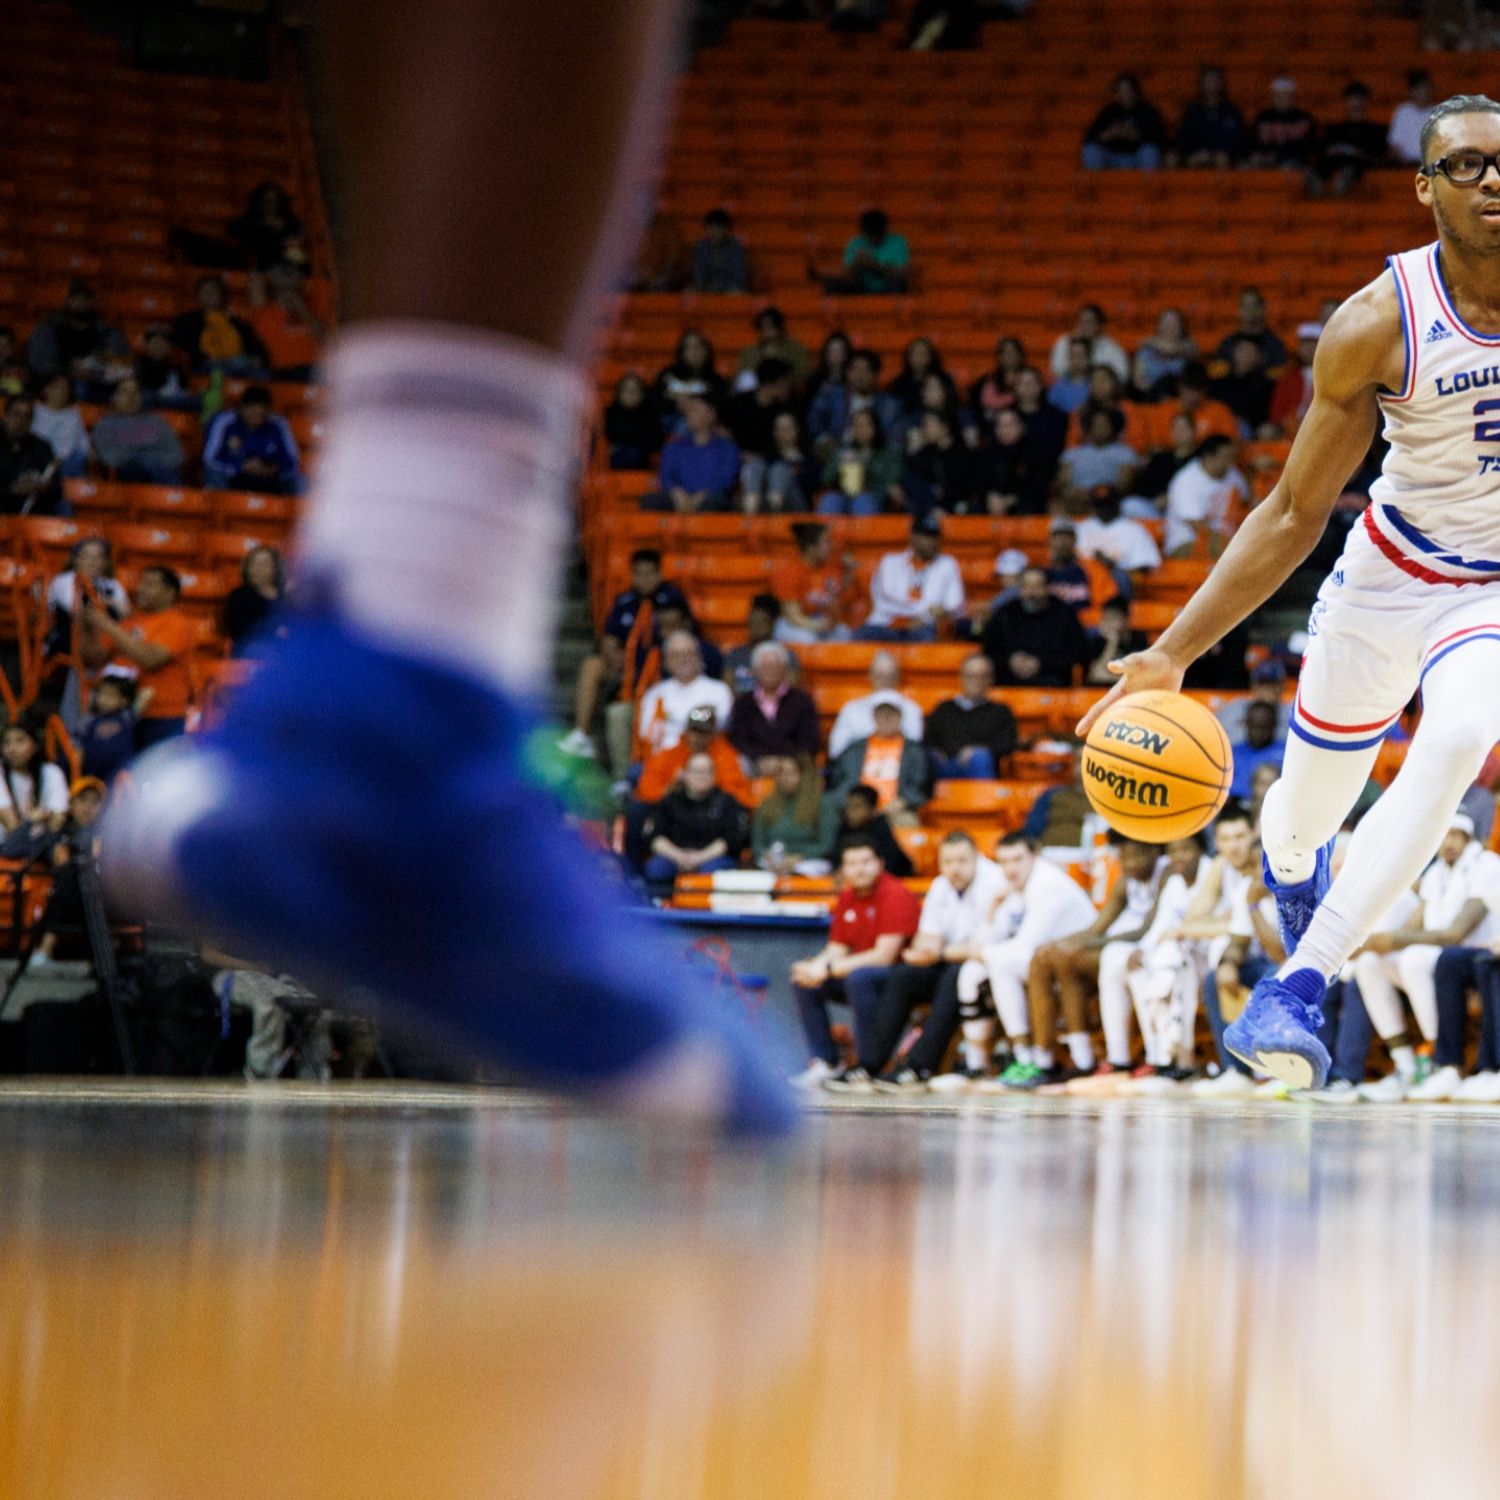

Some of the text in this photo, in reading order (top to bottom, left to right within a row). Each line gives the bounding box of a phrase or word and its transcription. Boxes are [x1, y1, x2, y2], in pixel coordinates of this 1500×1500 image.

[1424, 332, 1453, 344] adidas
[1104, 720, 1170, 756] NCAA
[1086, 758, 1169, 808] Wilson
